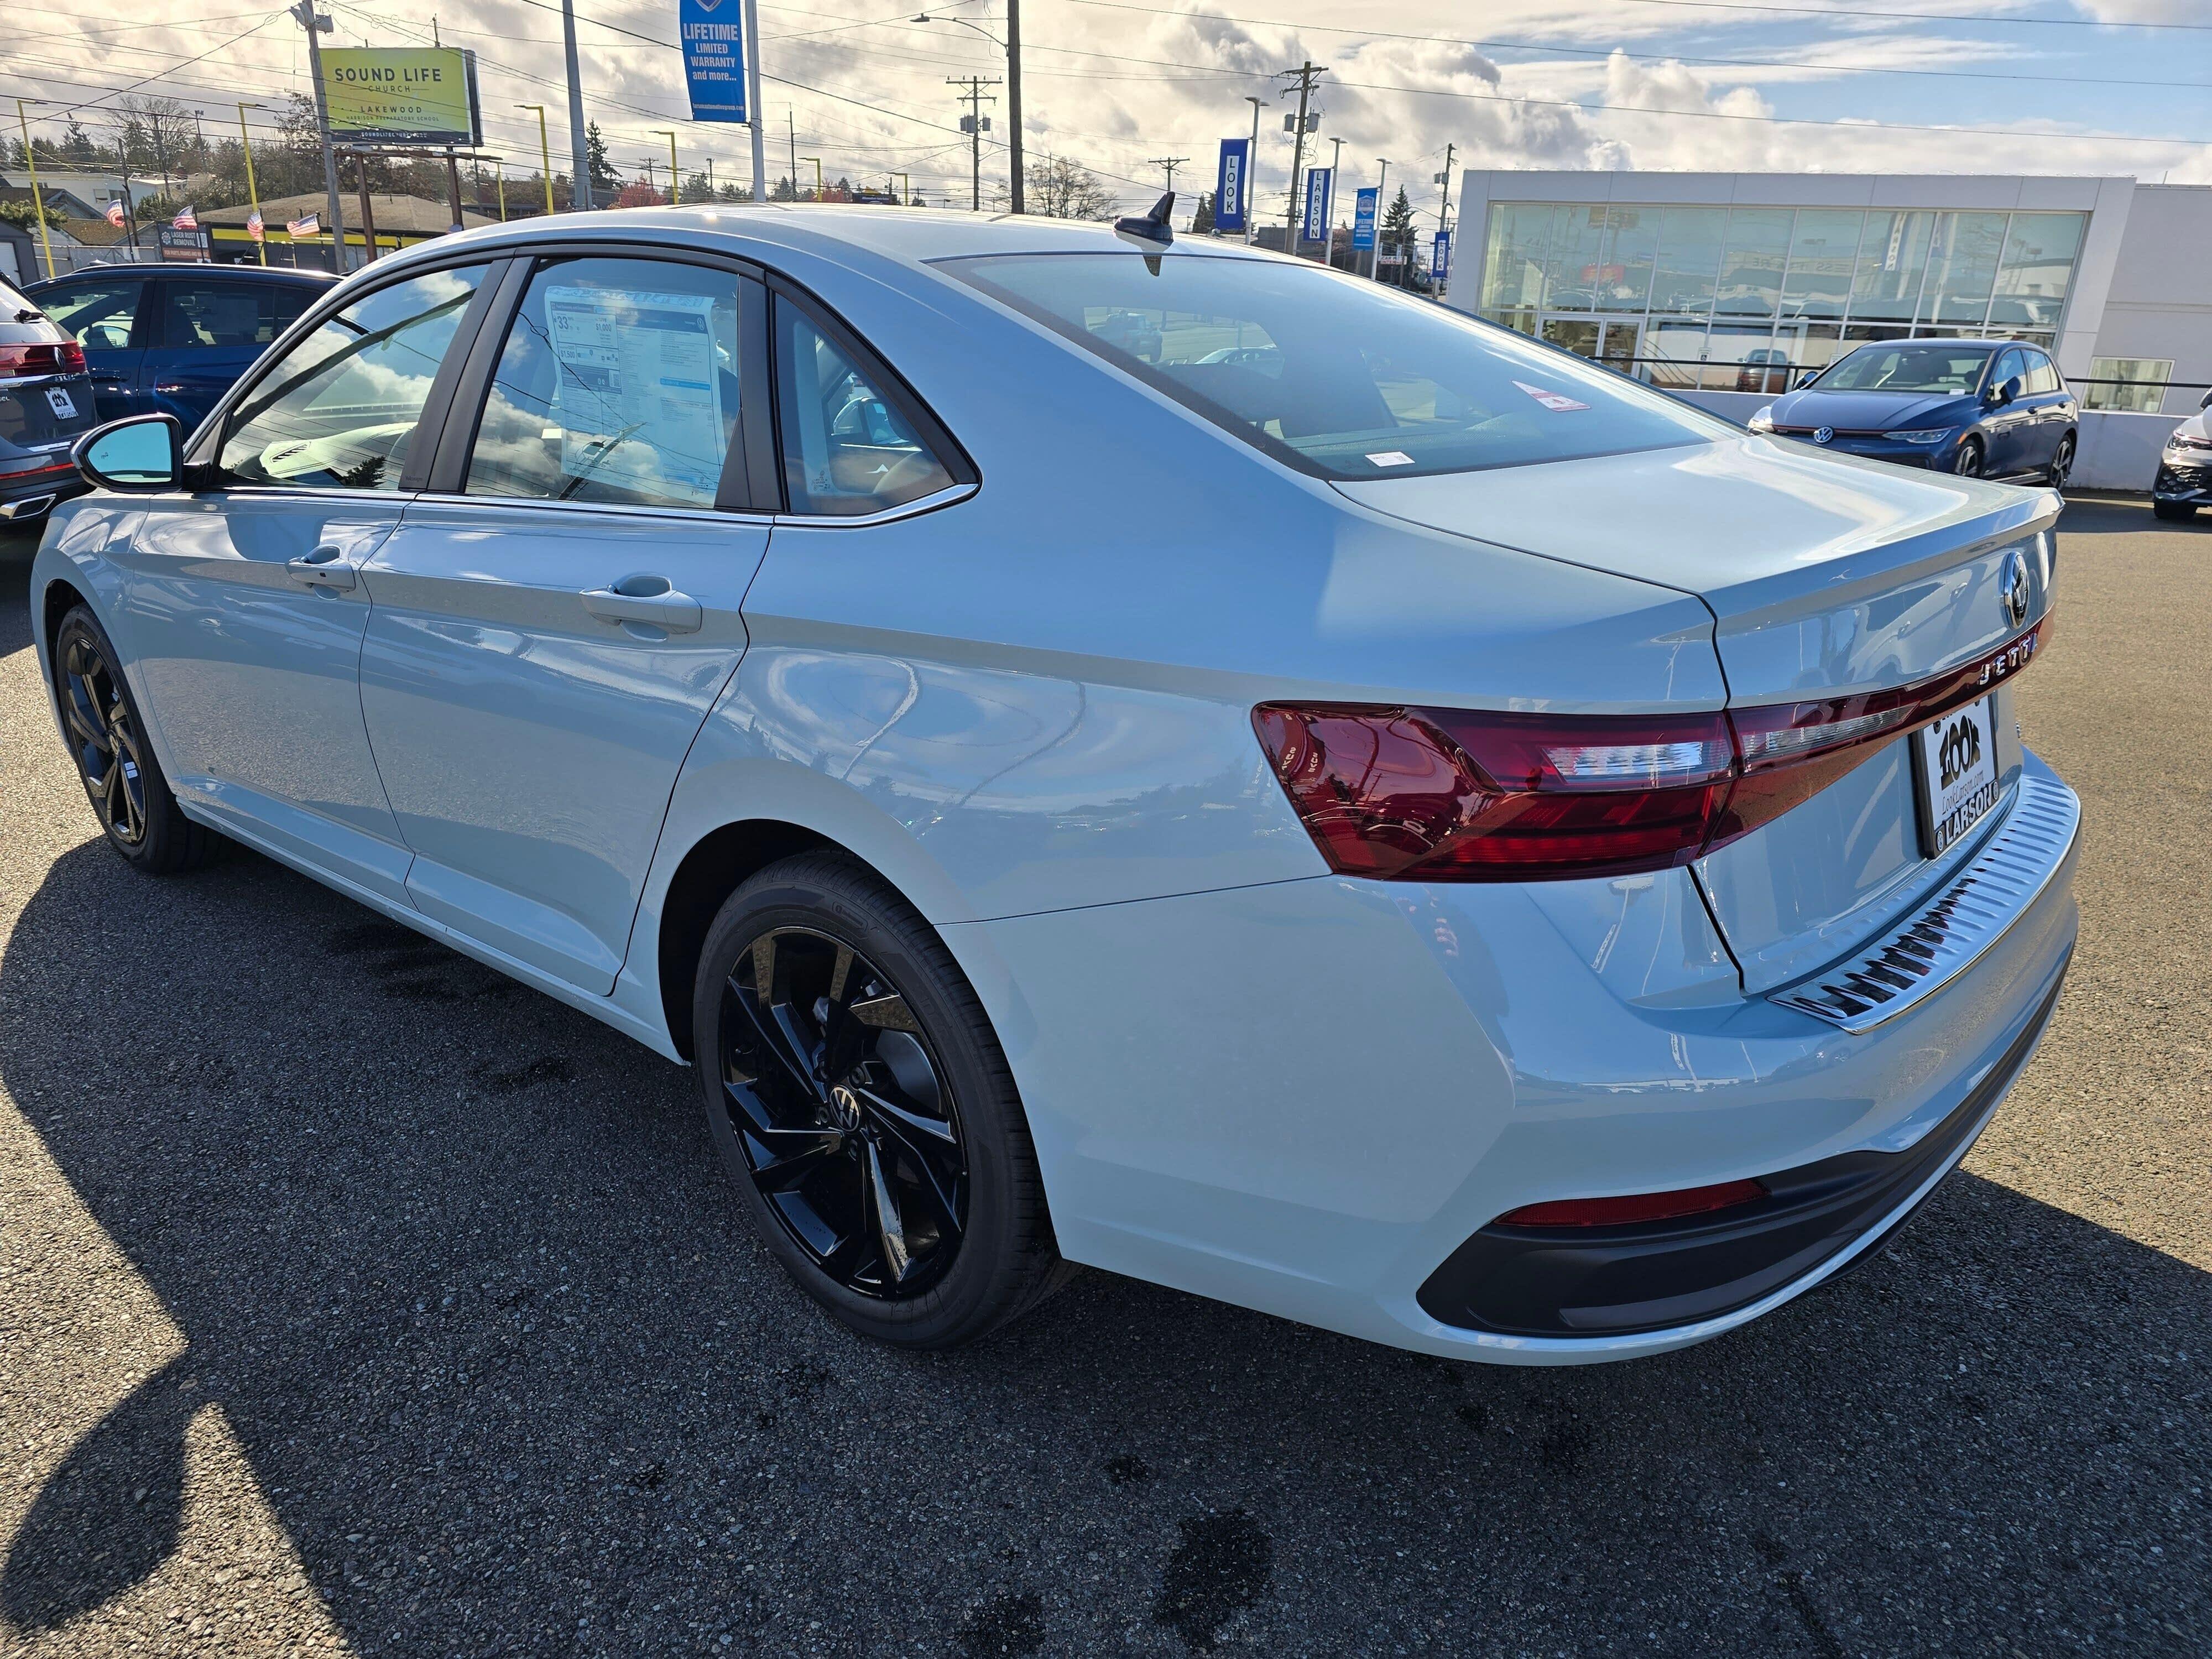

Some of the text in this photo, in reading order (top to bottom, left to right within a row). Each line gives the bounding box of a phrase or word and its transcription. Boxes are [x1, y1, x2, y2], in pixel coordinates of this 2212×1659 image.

[683, 23, 738, 40] LIFETIME
[696, 43, 728, 54] LIMITED
[691, 56, 735, 67] WARRANTY
[335, 67, 442, 82] SOUND LIFE
[693, 70, 737, 81] and more...
[1227, 158, 1236, 212] LOOK
[1311, 171, 1322, 238] LARSON
[557, 316, 569, 330] 33
[596, 323, 612, 332] $1,000
[561, 349, 575, 359] $1,500
[1945, 782, 1992, 846] LARSON
